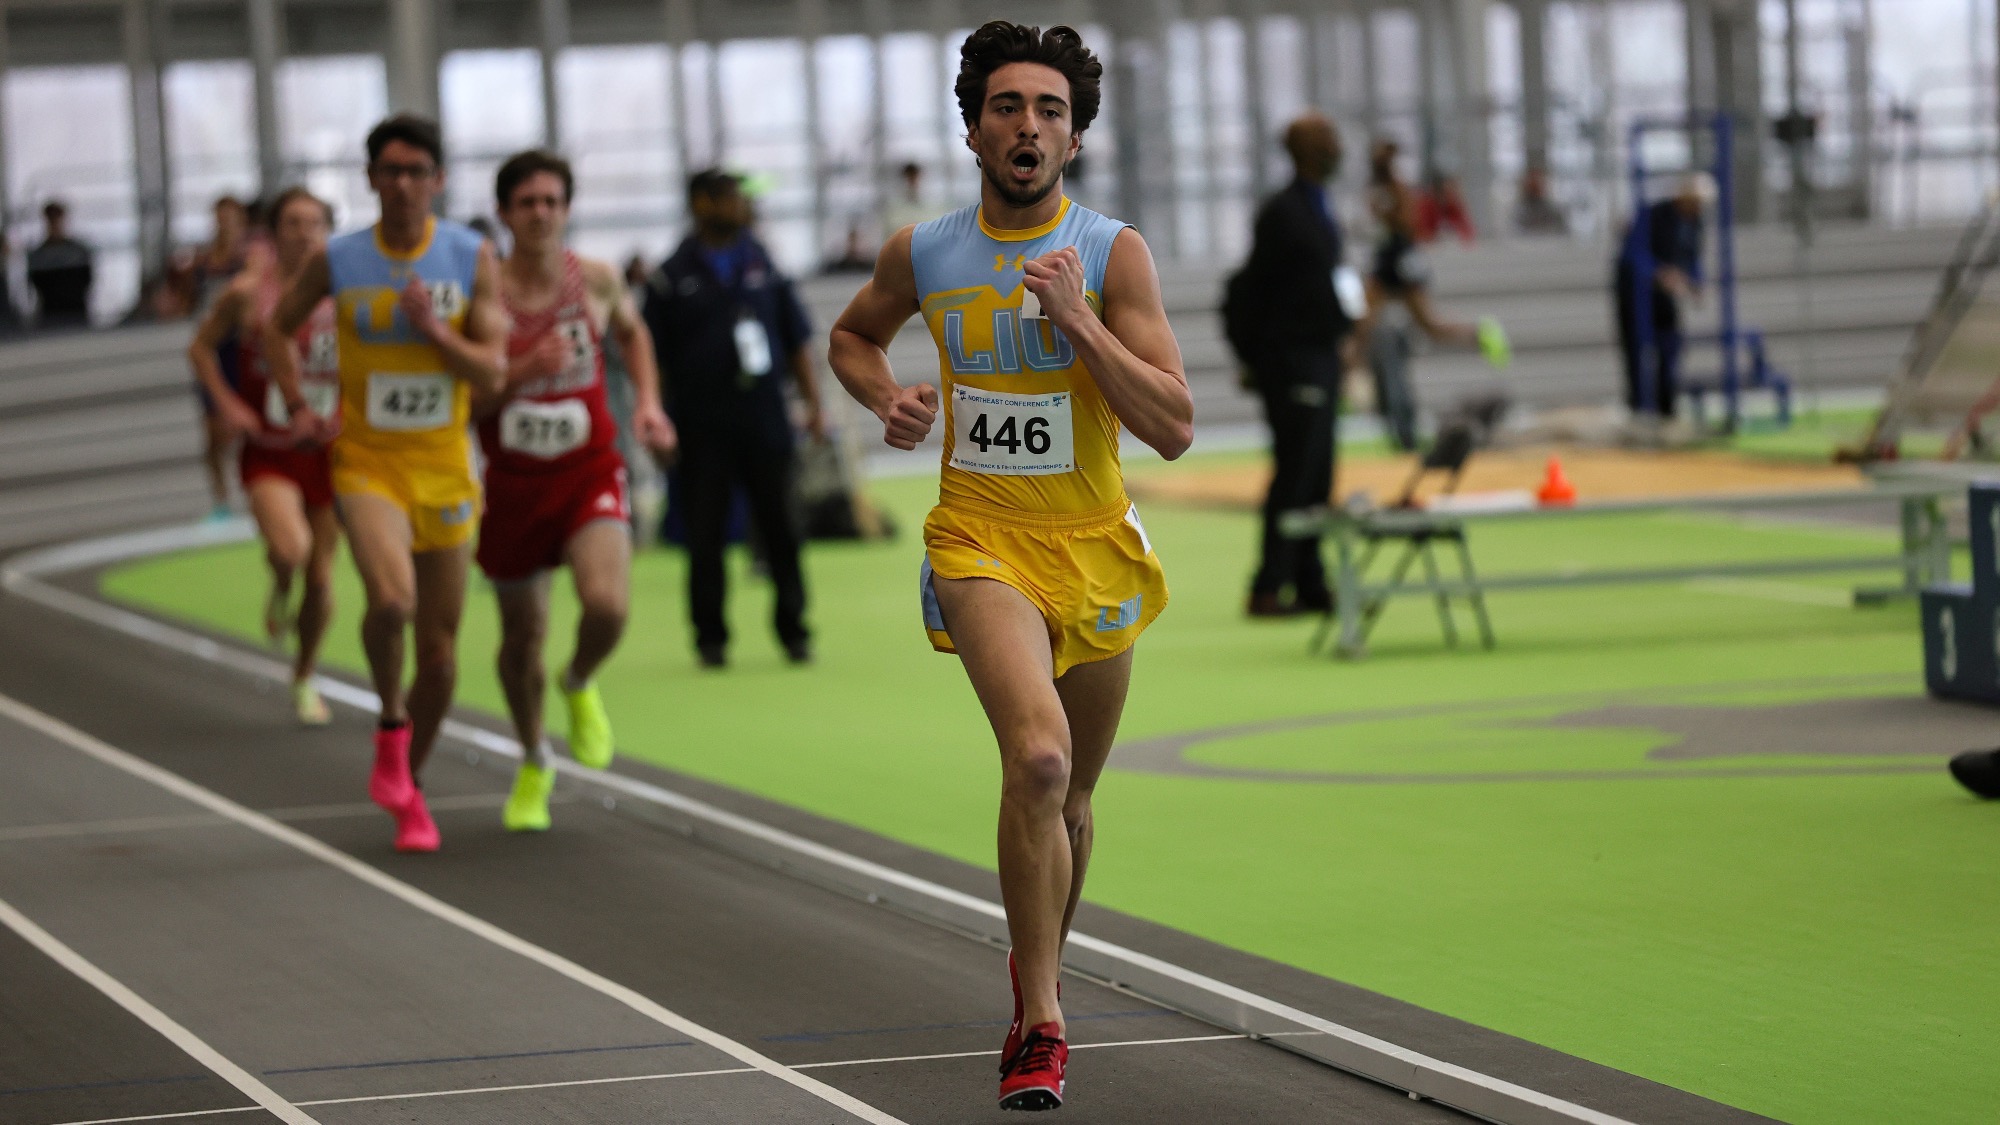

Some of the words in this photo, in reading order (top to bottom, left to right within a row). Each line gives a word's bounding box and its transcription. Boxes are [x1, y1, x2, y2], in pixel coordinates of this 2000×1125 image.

[943, 309, 1077, 375] LIU
[967, 394, 1003, 405] NORTHEAST
[1004, 399, 1050, 407] CONFERENCE
[968, 413, 1051, 455] 446
[1095, 593, 1142, 633] LIU
